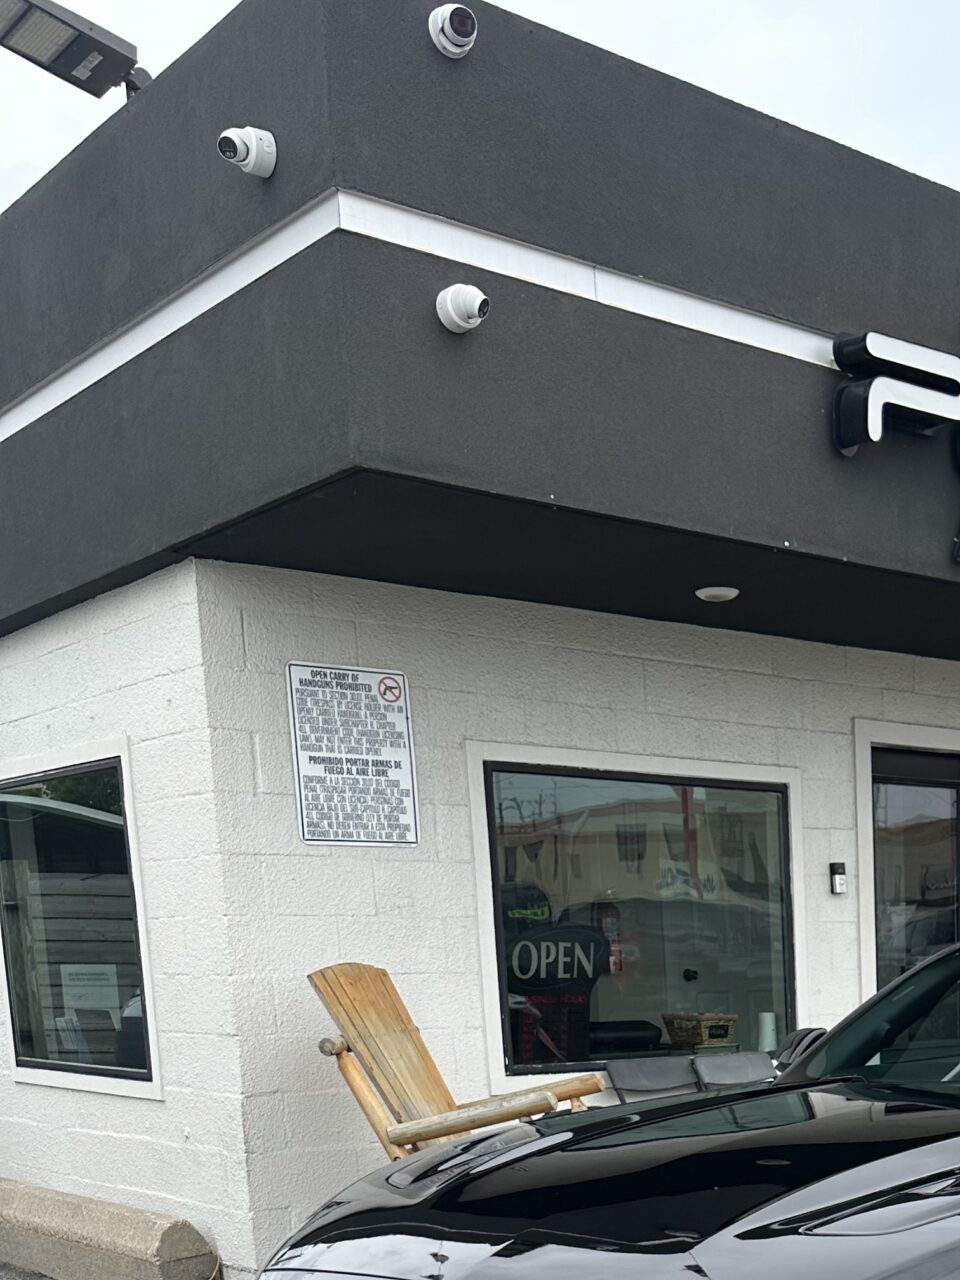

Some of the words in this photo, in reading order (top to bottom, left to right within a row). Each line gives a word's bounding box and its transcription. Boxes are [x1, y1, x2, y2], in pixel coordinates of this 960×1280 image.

[310, 669, 328, 679] OPEN
[329, 671, 350, 681] CARRY
[351, 673, 359, 682] OF
[299, 678, 333, 689] HANDGUNS
[335, 681, 371, 692] PROHIBITED
[308, 755, 344, 765] PROHIBIDO
[345, 757, 370, 767] PORTAR
[371, 759, 393, 768] ARMAS
[393, 760, 402, 768] DE
[324, 765, 345, 774] FUEGO
[346, 766, 353, 775] AL
[355, 767, 369, 776] AIRE
[371, 768, 388, 777] LIBRE
[511, 940, 595, 980] OPEN
